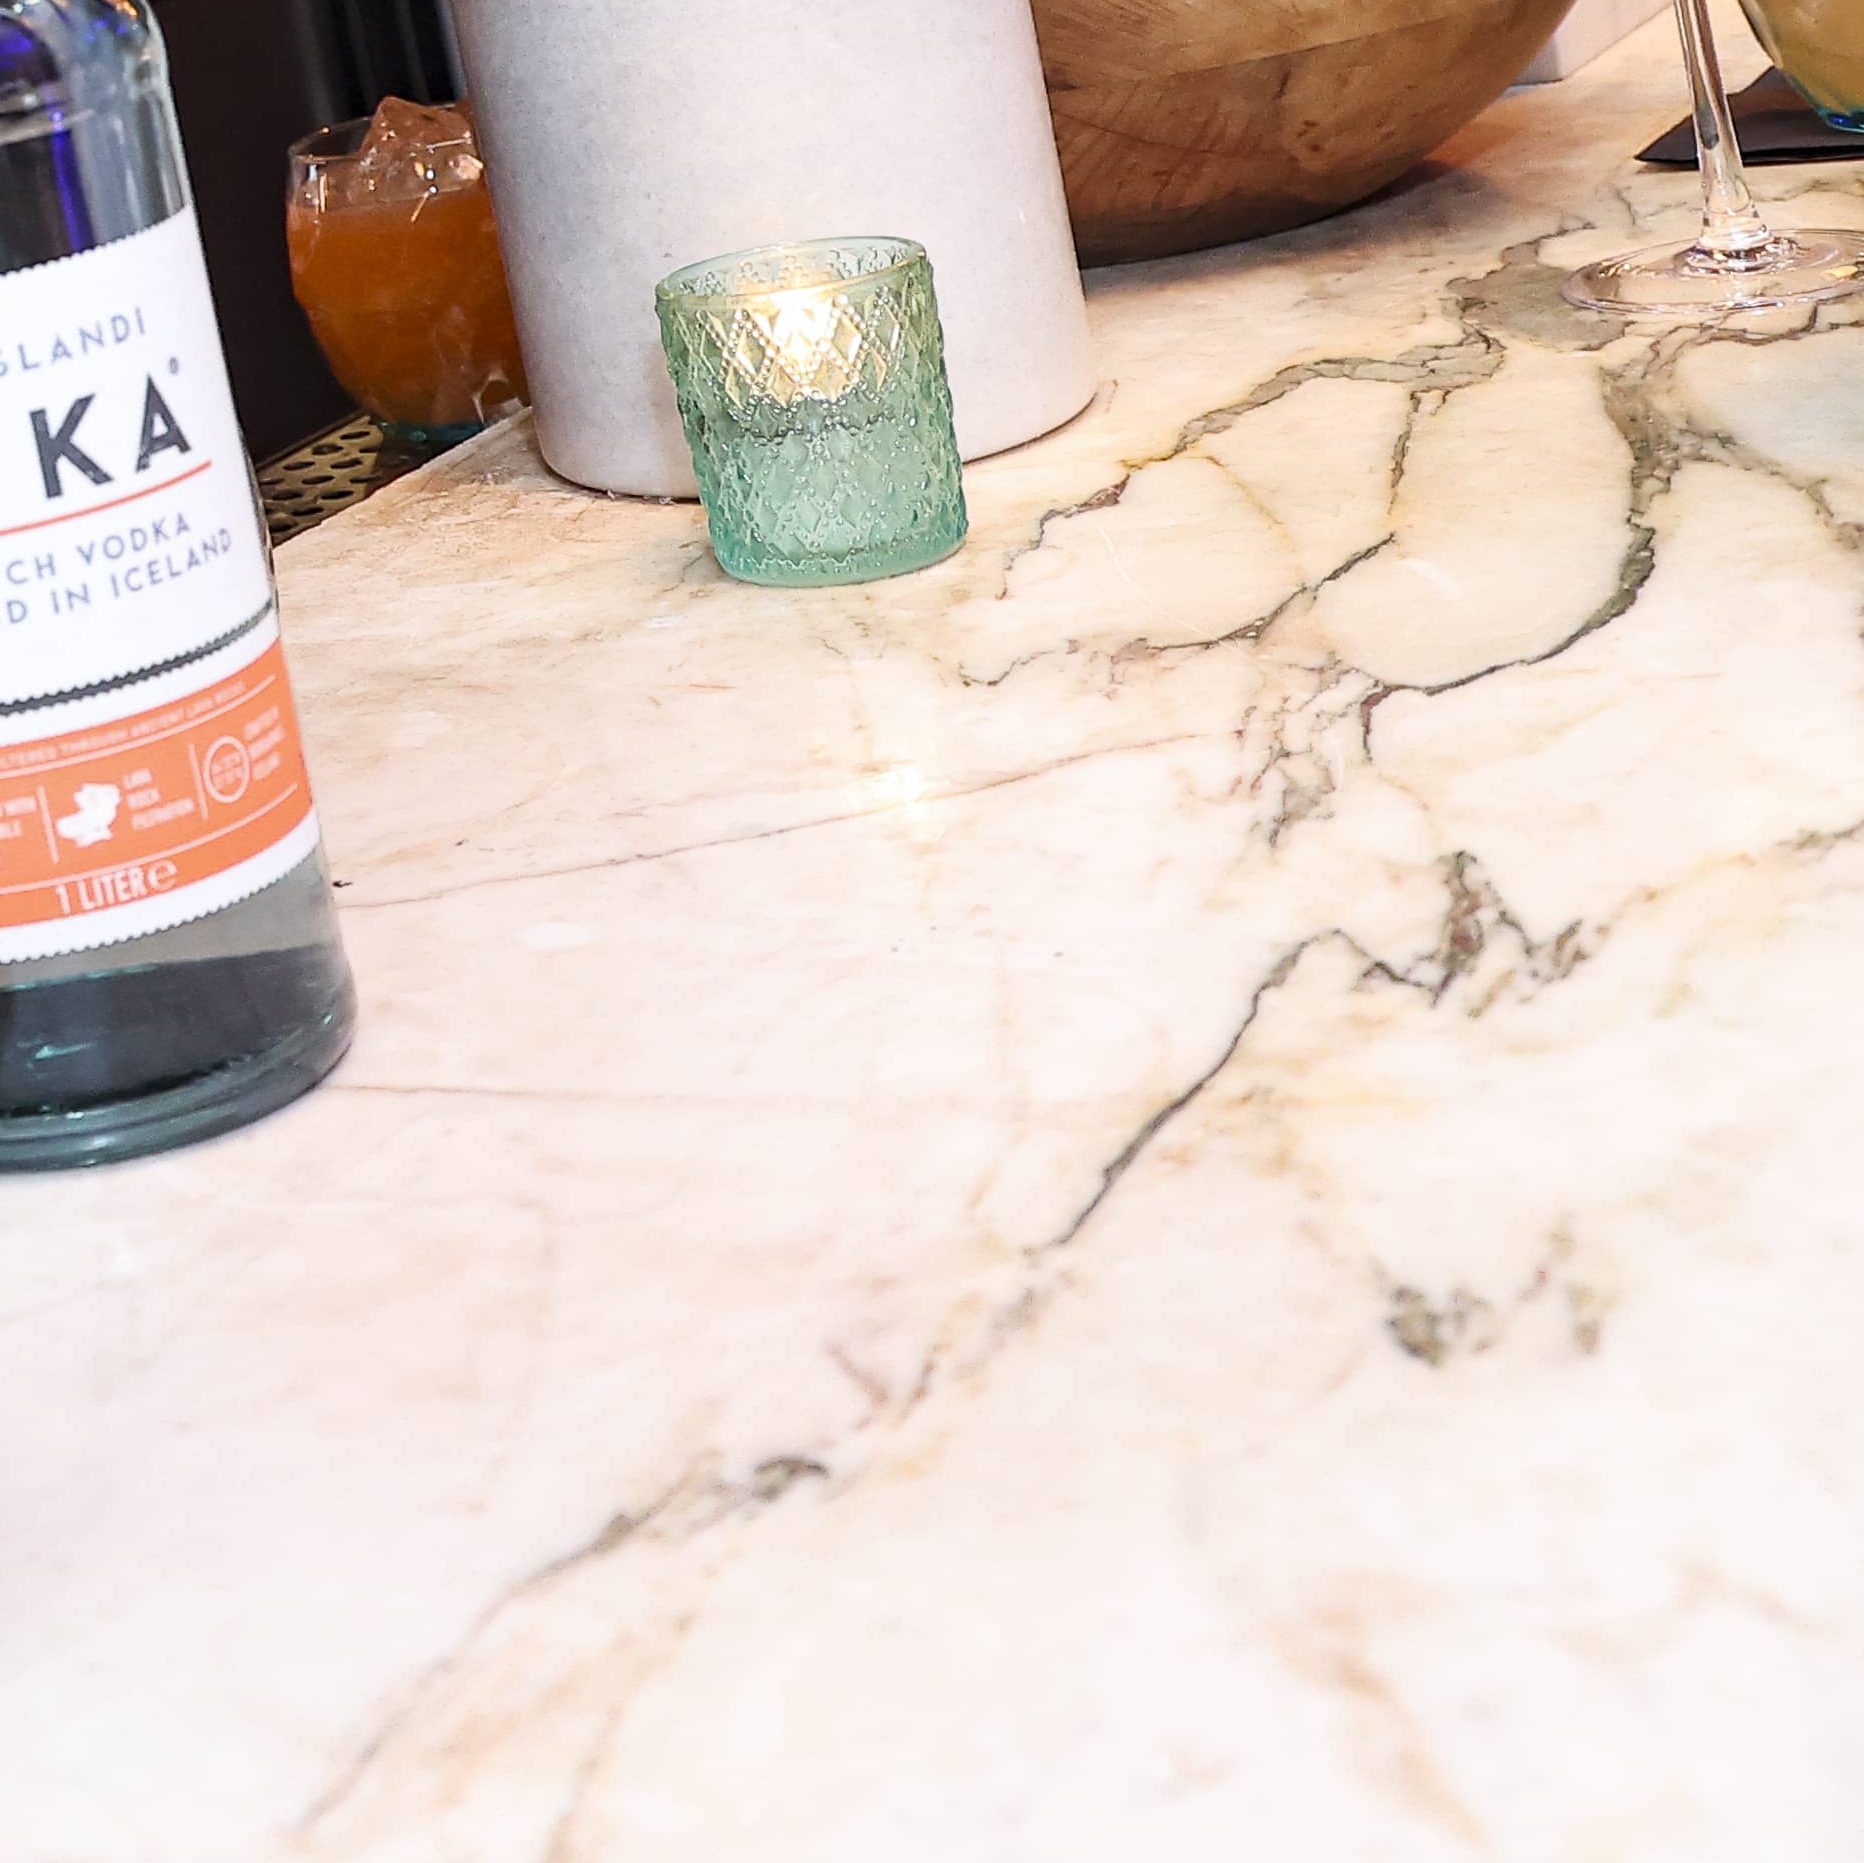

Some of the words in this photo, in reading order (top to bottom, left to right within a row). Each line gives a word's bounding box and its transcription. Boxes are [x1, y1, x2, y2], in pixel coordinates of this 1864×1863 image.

[76, 511, 192, 566] VODKA
[50, 582, 92, 616] IN
[110, 527, 233, 598] ICELAND
[54, 886, 72, 915] 1
[78, 867, 146, 911] LITER
